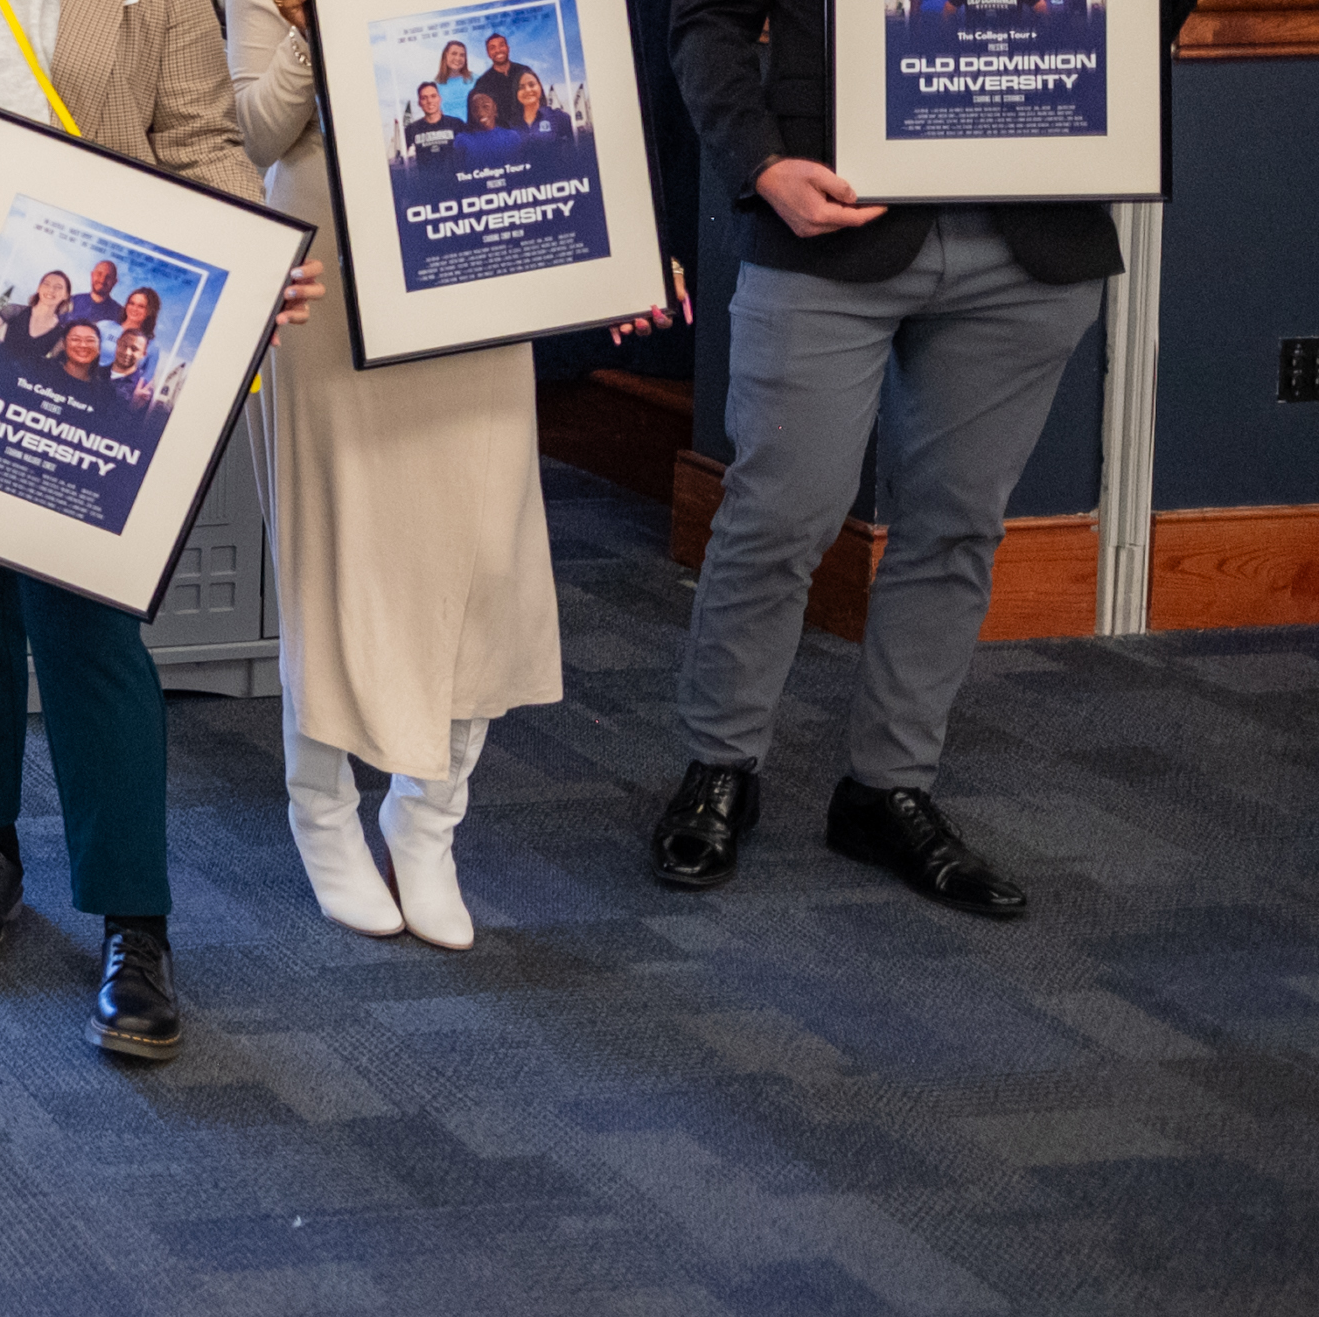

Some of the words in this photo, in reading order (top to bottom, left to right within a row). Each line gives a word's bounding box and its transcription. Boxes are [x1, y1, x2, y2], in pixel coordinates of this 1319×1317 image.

[957, 32, 973, 40] The
[975, 31, 1007, 41] College
[1009, 31, 1030, 39] Tour
[901, 58, 955, 73] OLD
[960, 54, 1096, 71] DOMINION
[919, 74, 1078, 92] UNIVERSITY
[407, 201, 458, 222] OLD
[462, 178, 589, 213] DOMINION
[427, 200, 574, 239] UNIVERSITY
[6, 404, 140, 464] DOMINION
